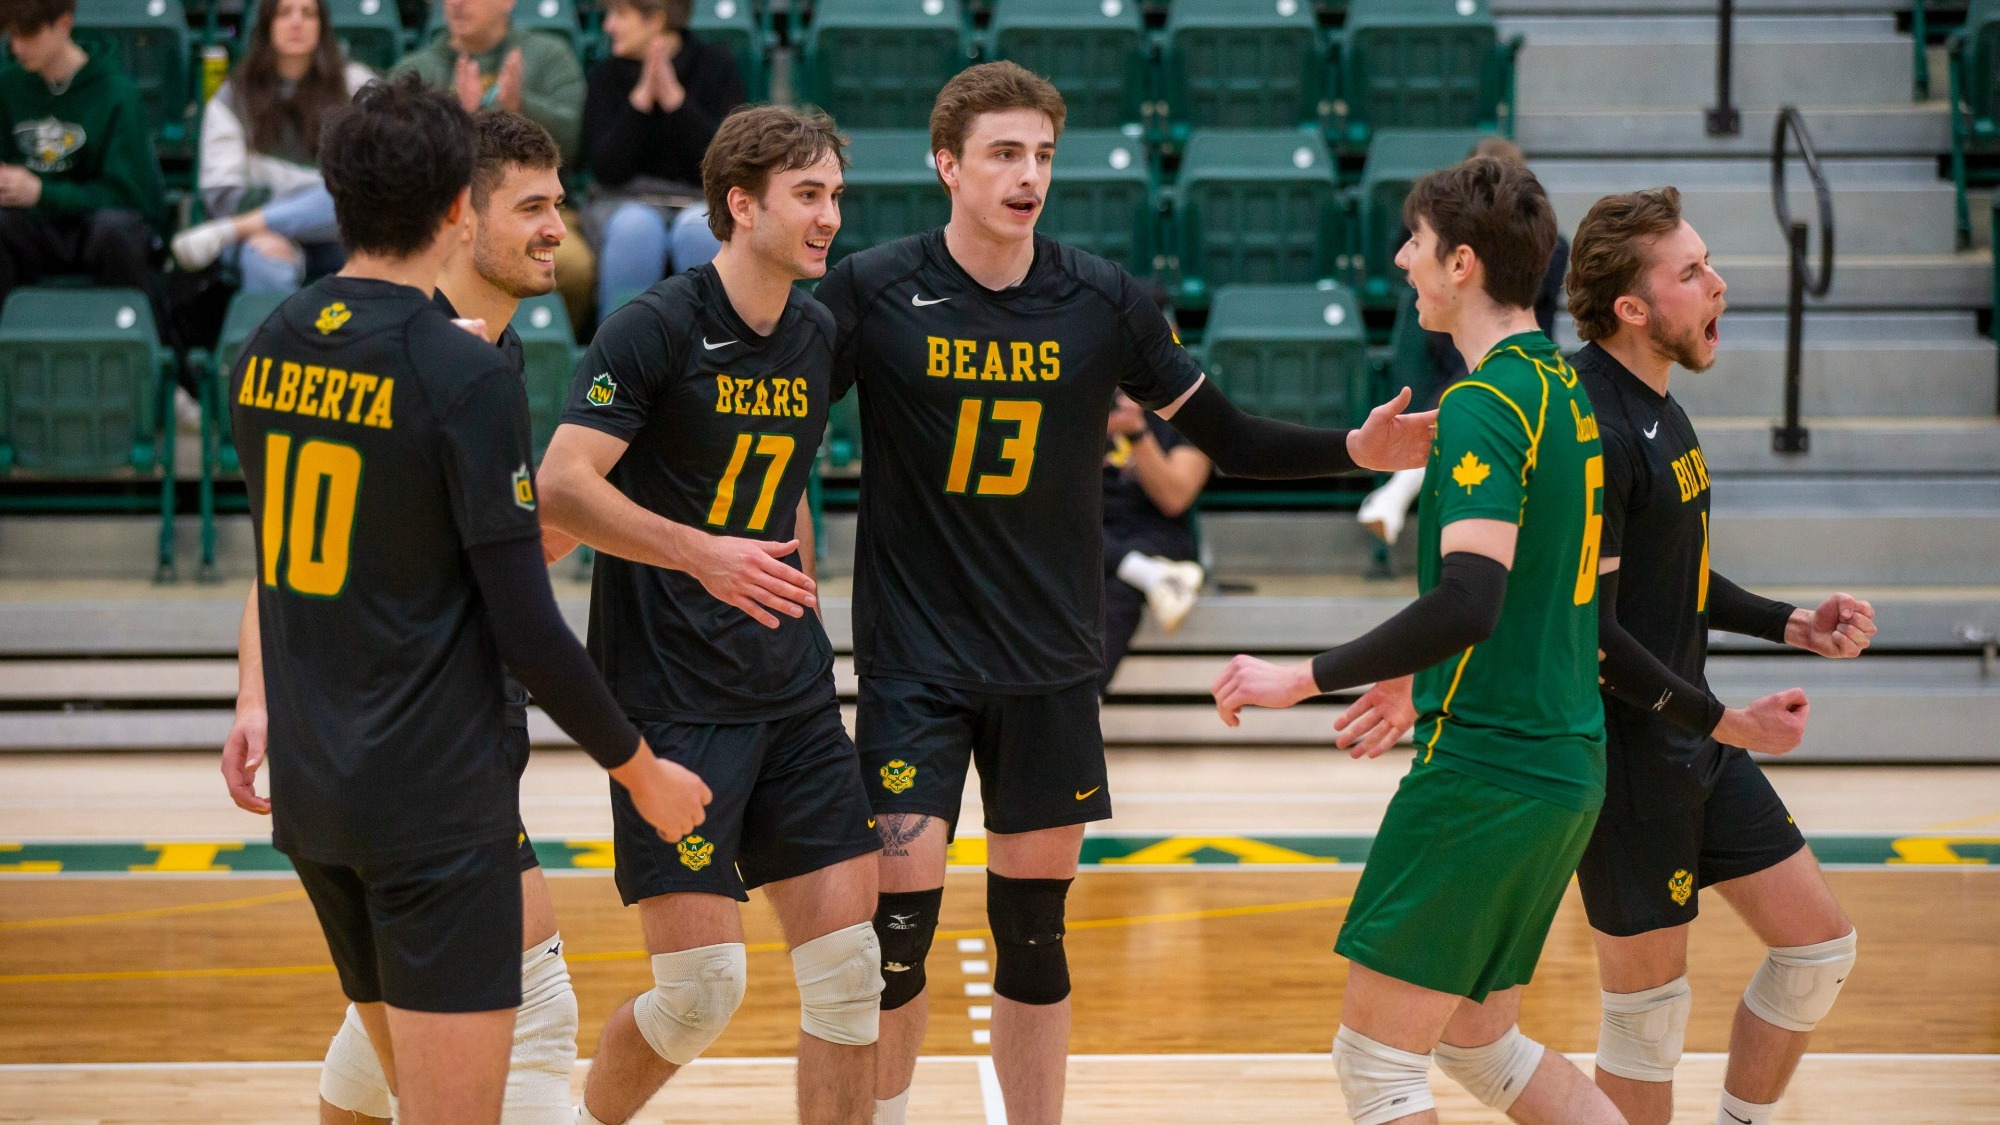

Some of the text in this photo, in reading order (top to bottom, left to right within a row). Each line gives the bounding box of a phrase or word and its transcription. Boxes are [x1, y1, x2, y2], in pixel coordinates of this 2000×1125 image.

[238, 355, 394, 430] ALBERTA
[716, 373, 808, 418] BEARS
[927, 335, 1060, 382] BEARS
[706, 432, 796, 532] 17
[944, 398, 1043, 497] 13
[261, 431, 363, 598] 10
[882, 848, 909, 858] ROMA
